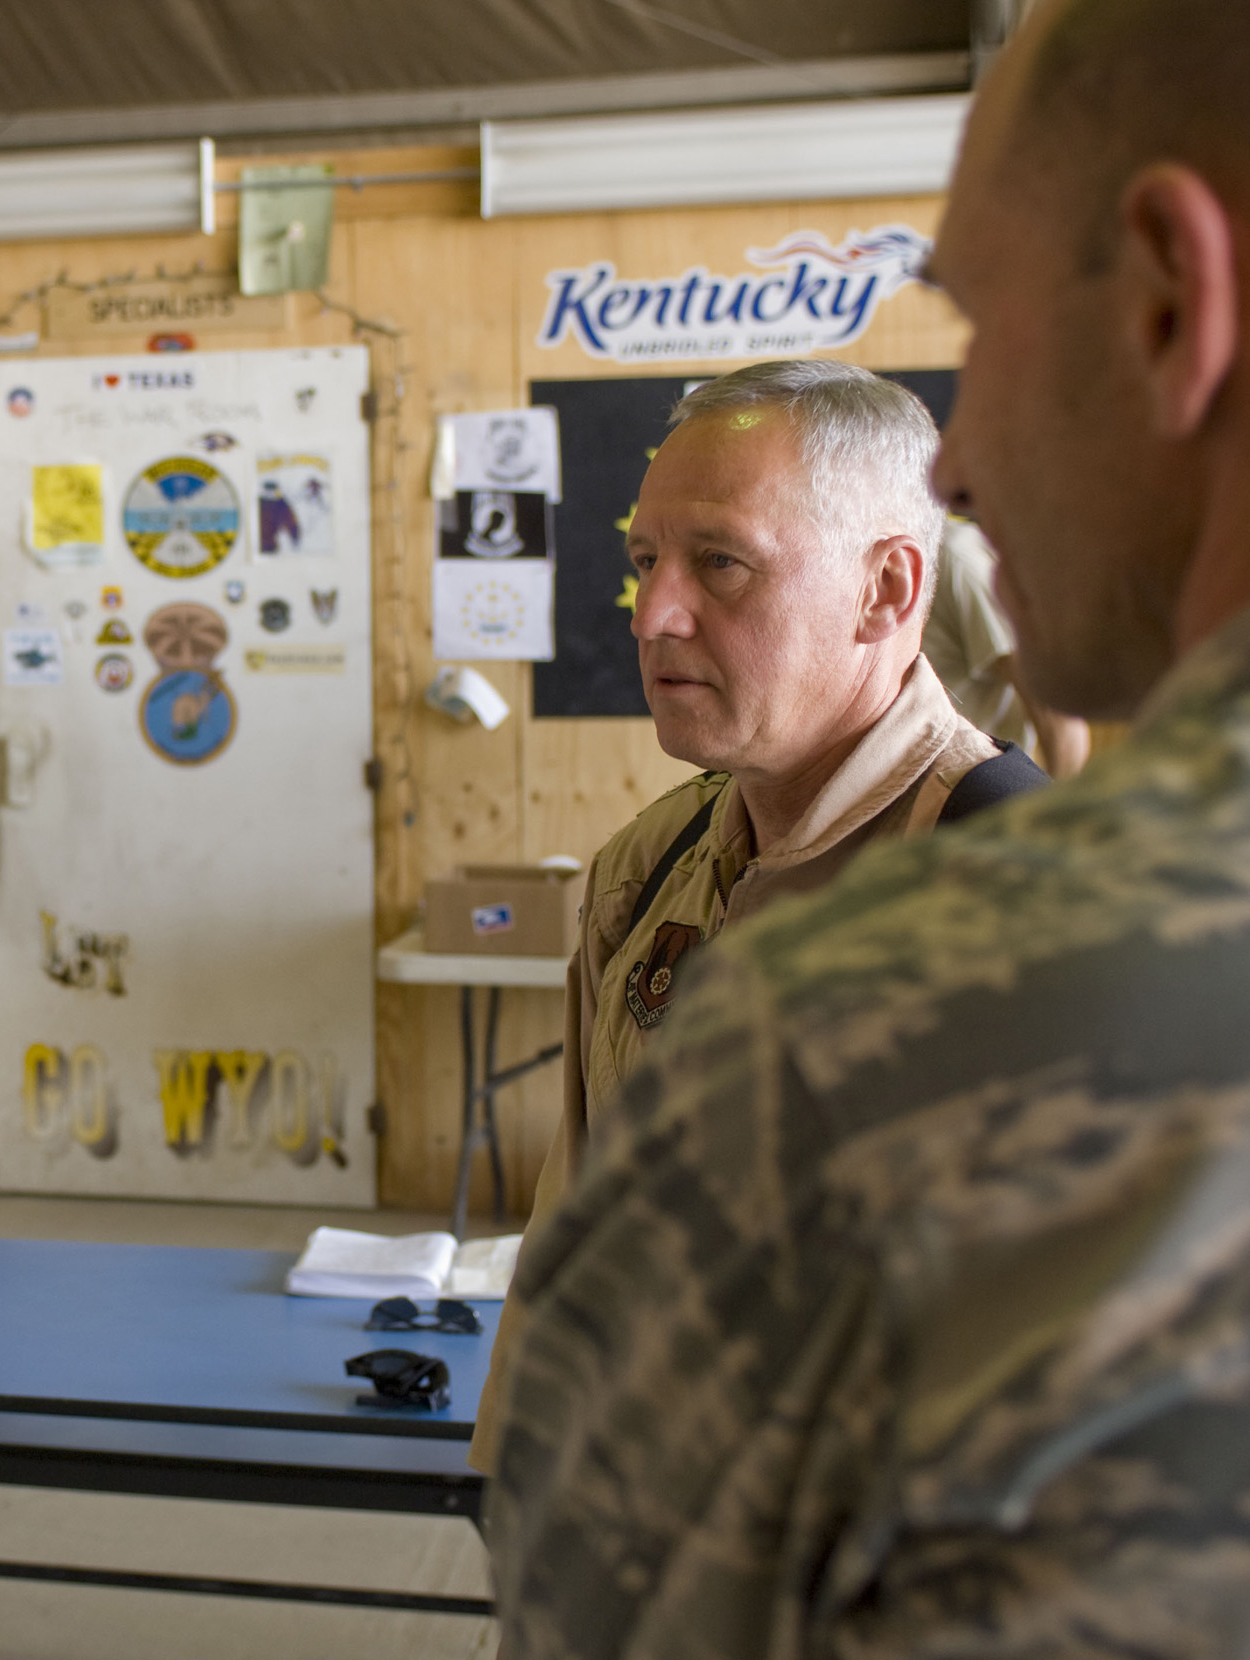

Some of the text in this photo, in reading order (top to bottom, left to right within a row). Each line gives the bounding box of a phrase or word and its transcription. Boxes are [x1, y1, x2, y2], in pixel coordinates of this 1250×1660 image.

[545, 262, 877, 351] Kentucky
[748, 333, 814, 350] SPIRIT
[128, 369, 195, 389] TEXAS
[23, 1042, 112, 1149] GO
